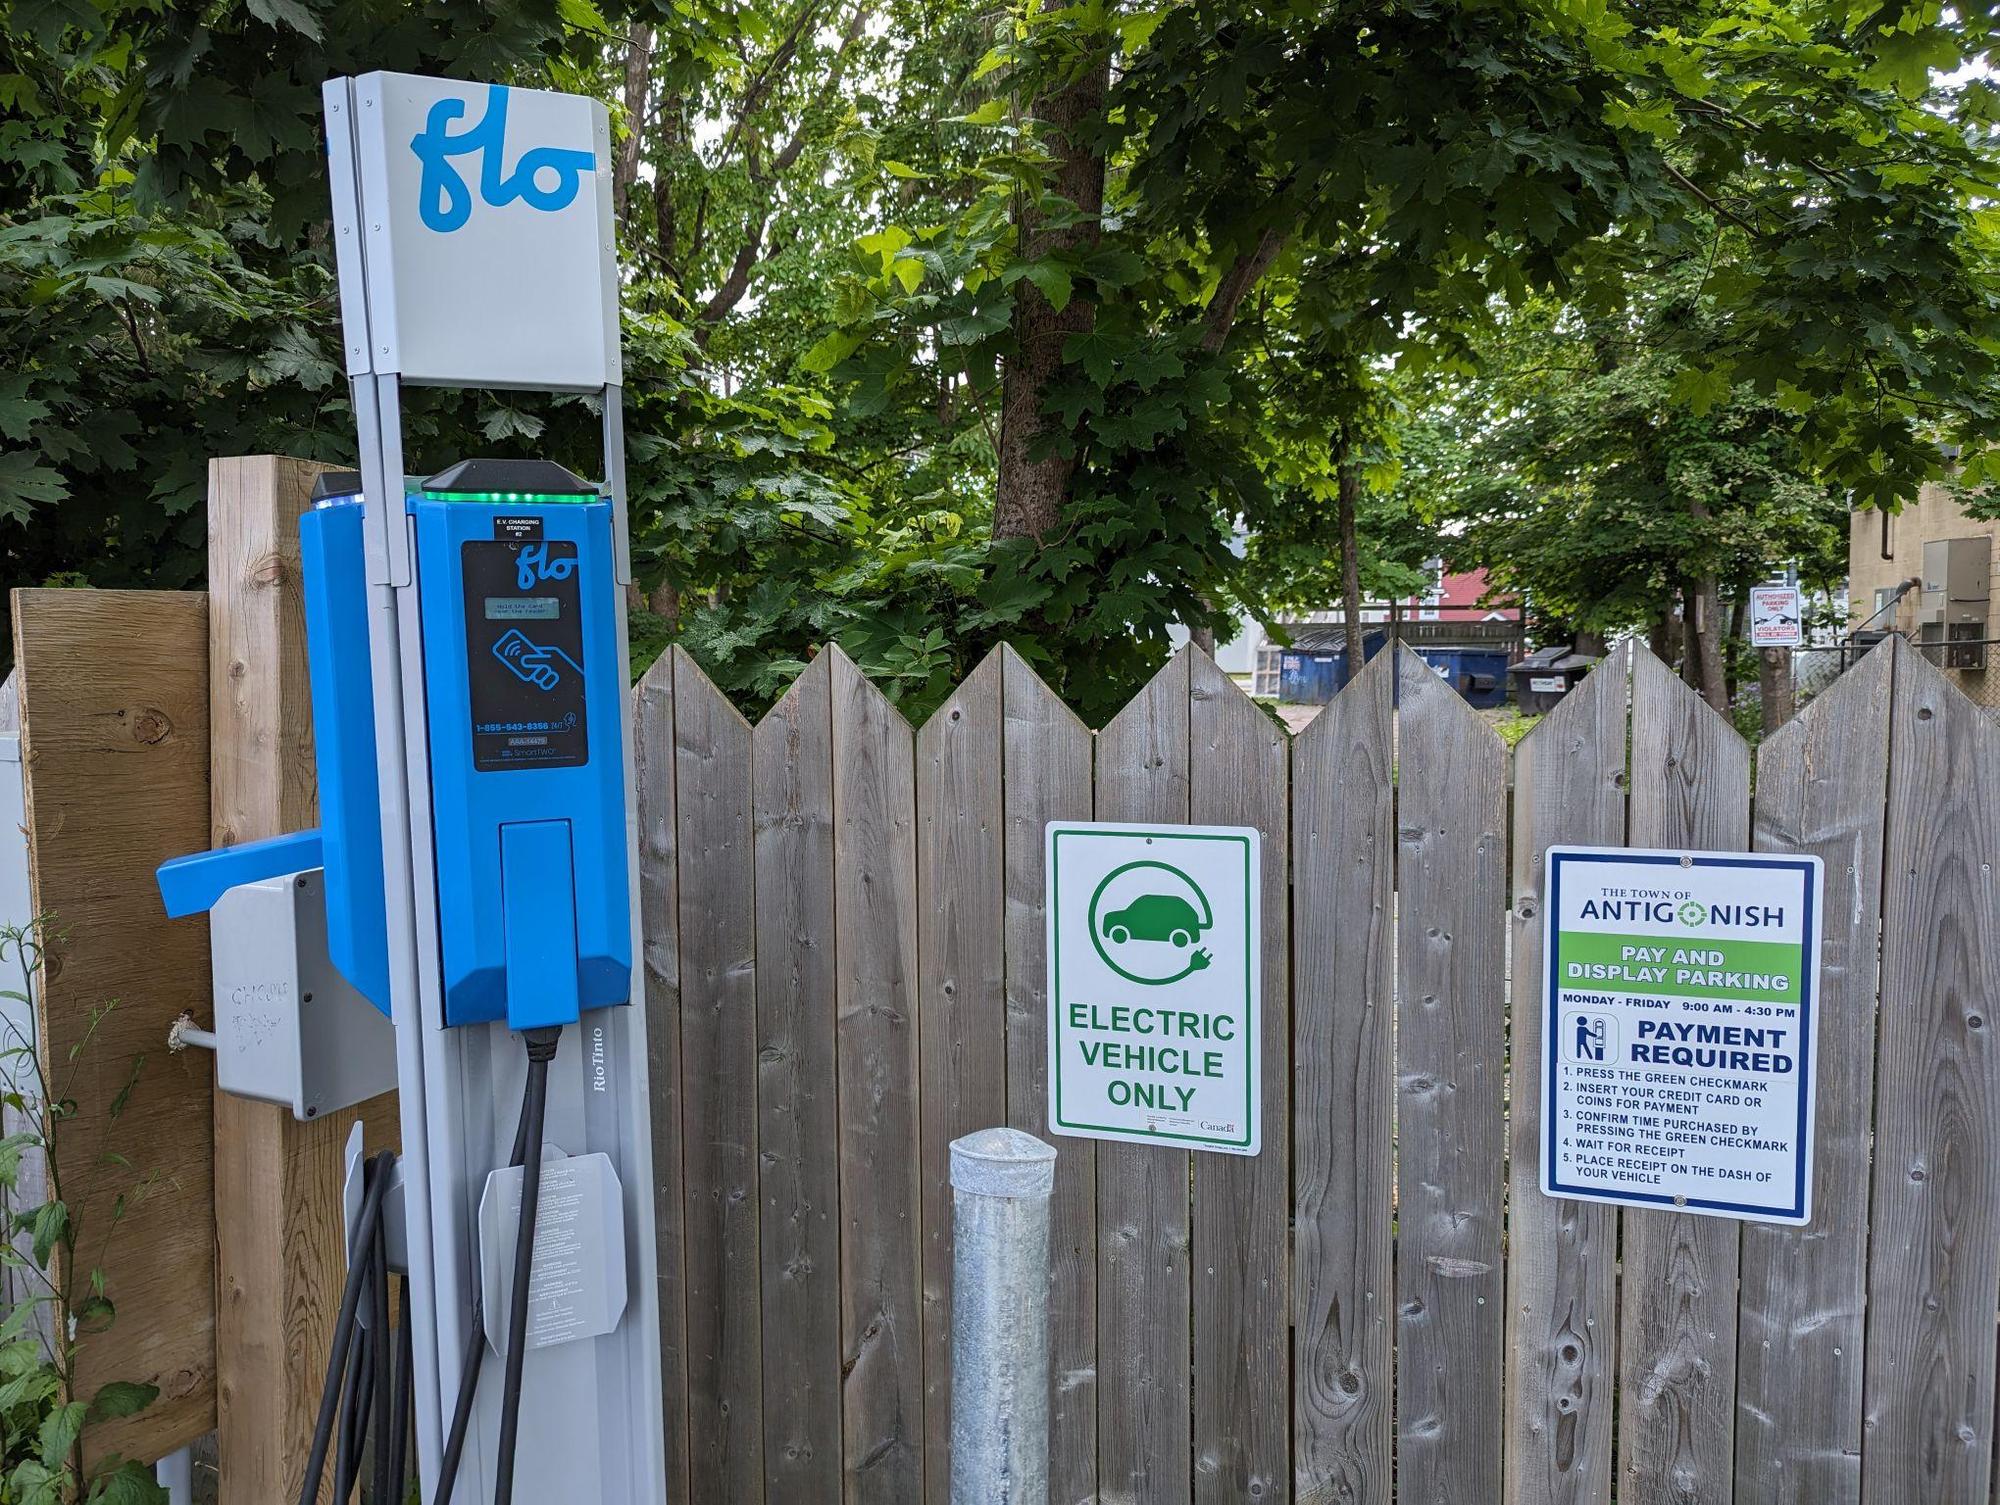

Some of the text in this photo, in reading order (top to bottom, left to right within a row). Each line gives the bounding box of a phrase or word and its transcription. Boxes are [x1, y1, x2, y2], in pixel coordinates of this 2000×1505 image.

[410, 83, 596, 233] flo
[515, 541, 578, 590] flo
[1600, 887, 1691, 900] THE TOWN OF
[1580, 900, 1784, 928] ANTIGONISH
[1621, 946, 1725, 967] PAY AND
[1567, 962, 1790, 991] DISPLAY PARKING
[1563, 994, 1615, 1006] MONDAY
[1626, 998, 1671, 1009] FRIDAY
[1682, 1002, 1710, 1013] 9:00
[1713, 1003, 1733, 1014] AM
[1745, 1005, 1772, 1017] 4:30
[1776, 1007, 1795, 1018] PM
[1069, 1002, 1235, 1041] ELECTRIC
[1638, 1020, 1786, 1049] PAYMENT
[1079, 1040, 1224, 1078] VEHICLE
[1631, 1044, 1793, 1074] REQUIRED
[1564, 1067, 1768, 1092] 1. PRESS THE GREEN CHECKMARK
[1107, 1079, 1197, 1112] ONLY
[1563, 1082, 1762, 1108] 2. INSERT YOUR CREDIT CARD OR
[1576, 1095, 1699, 1115] COINS FOR PAYMENT
[1200, 1120, 1234, 1133] Canada
[1563, 1110, 1759, 1137] 3. CONFIRM TIME PURCHASED BY
[1576, 1123, 1788, 1152] PRESSING THE GREEN CHECKMARK
[1563, 1138, 1685, 1158] 4. WAIT FOR RECEIPT
[1563, 1153, 1772, 1183] 5. PLACE RECEIPT ON THE DASH OF
[1576, 1166, 1661, 1184] YOUR VEHICLE
